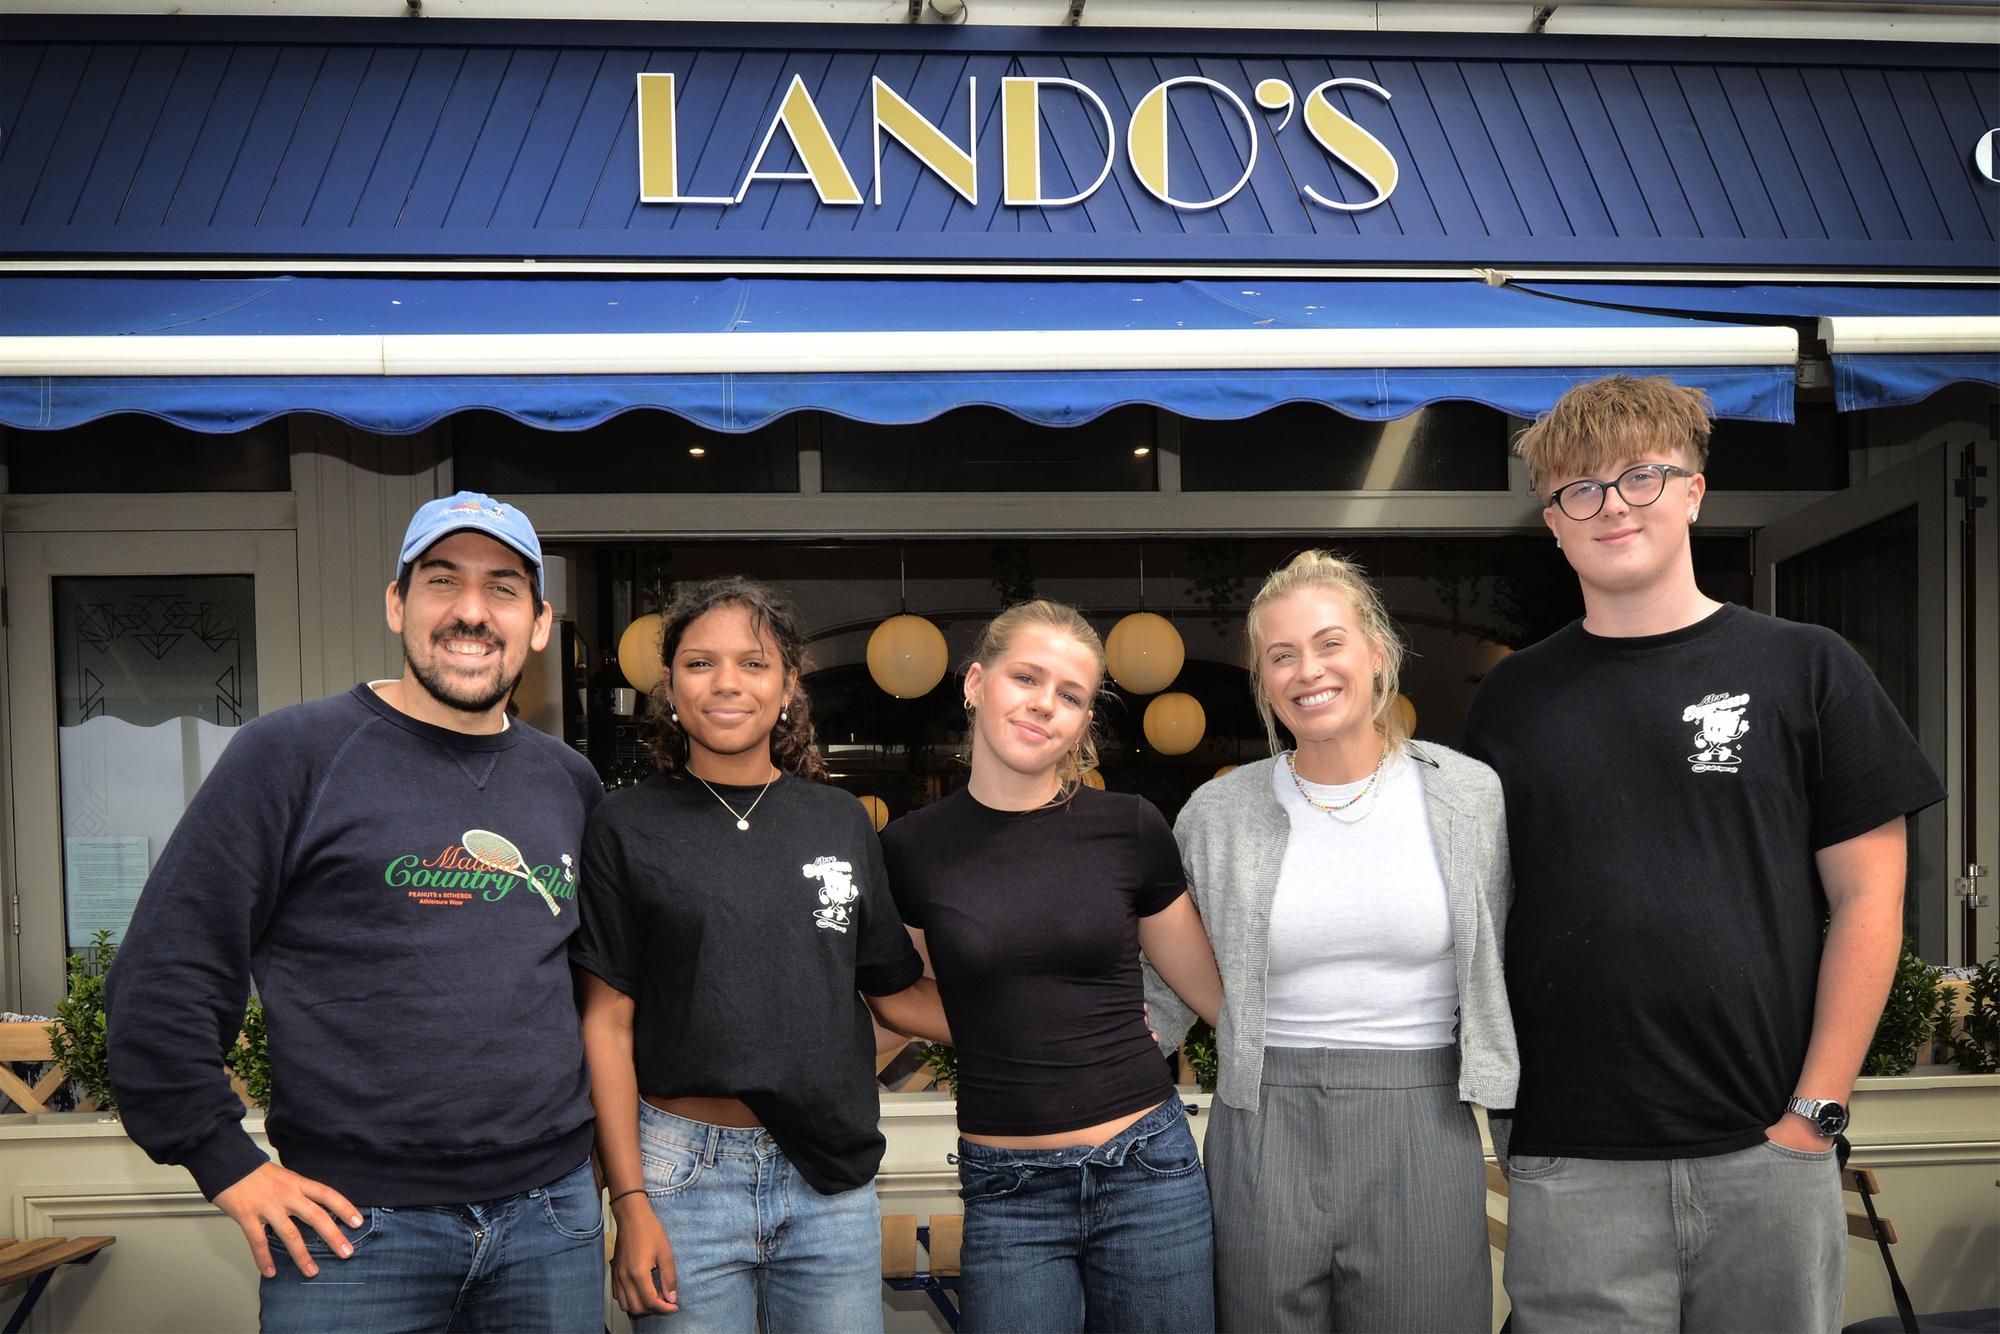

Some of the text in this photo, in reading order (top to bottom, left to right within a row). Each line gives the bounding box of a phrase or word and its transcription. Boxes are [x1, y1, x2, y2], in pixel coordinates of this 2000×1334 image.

[636, 72, 1399, 211] LANDO'S
[422, 845, 521, 872] Malibu
[384, 854, 520, 902] Country
[408, 890, 438, 899] PEANUTS
